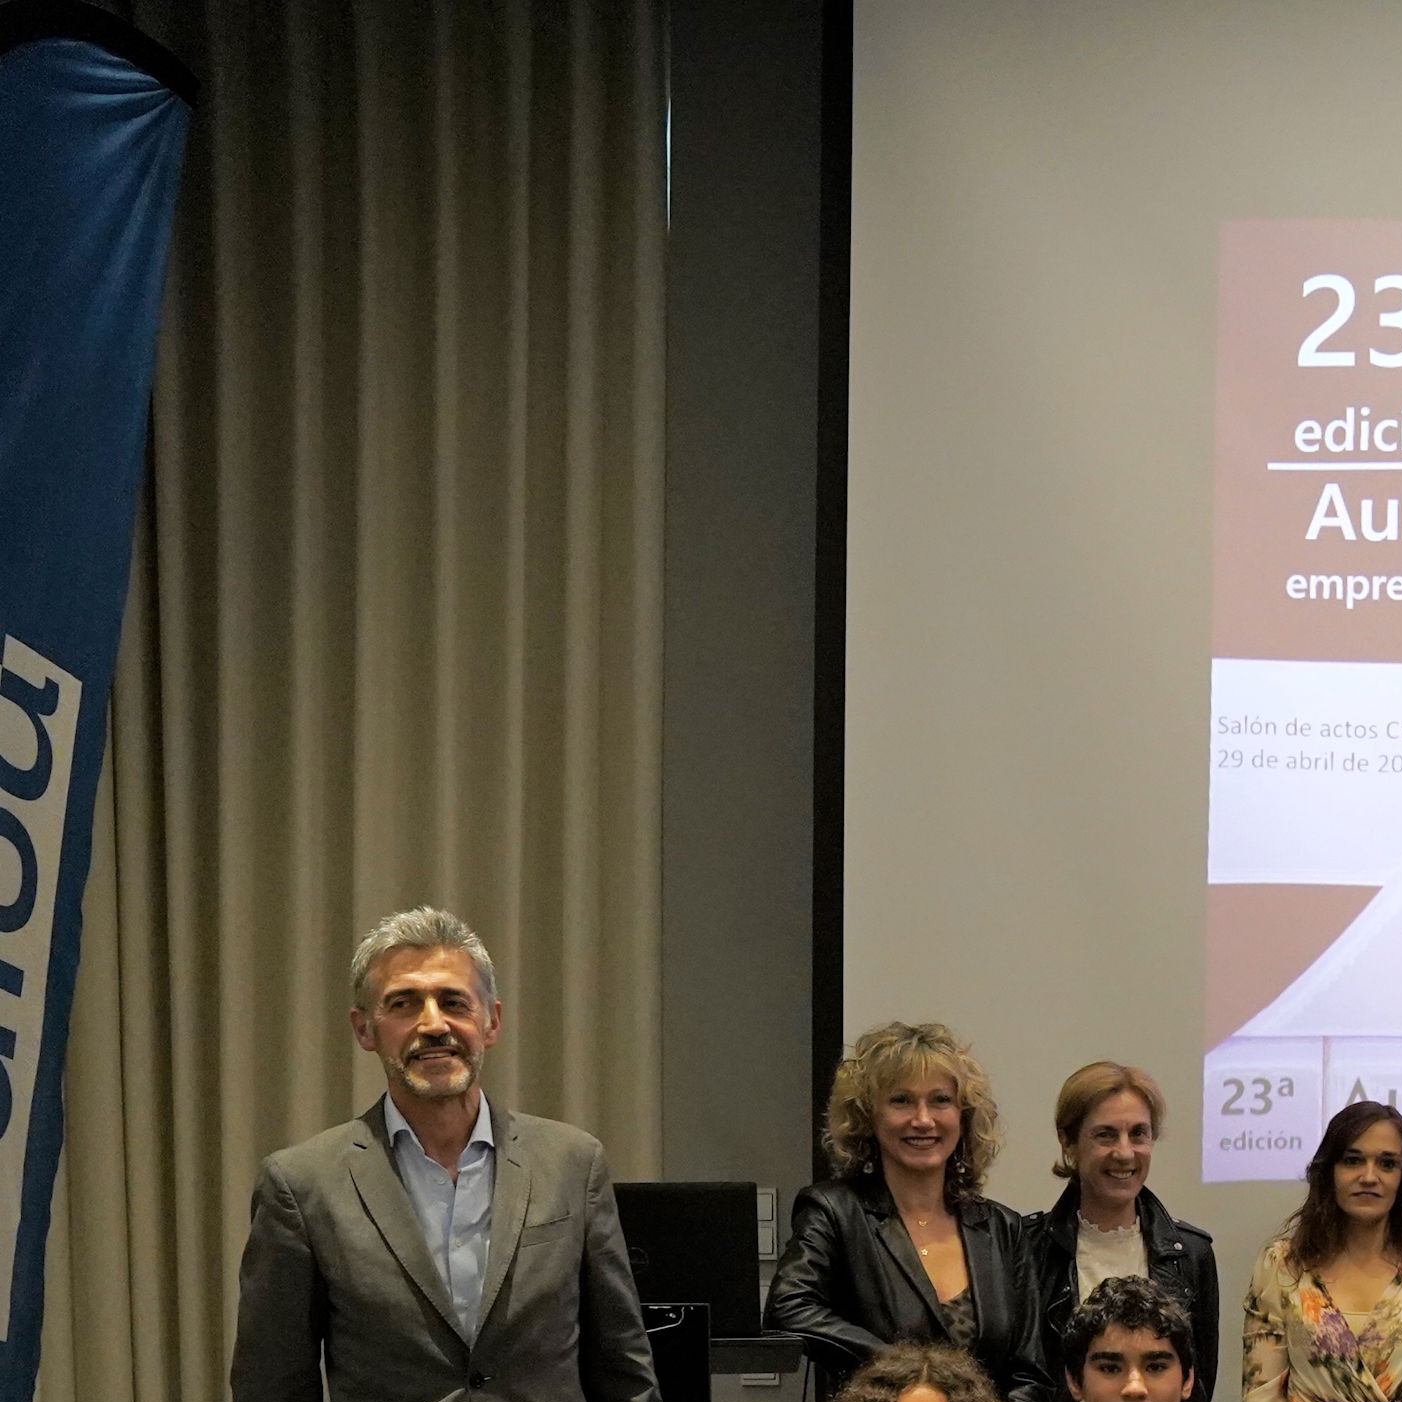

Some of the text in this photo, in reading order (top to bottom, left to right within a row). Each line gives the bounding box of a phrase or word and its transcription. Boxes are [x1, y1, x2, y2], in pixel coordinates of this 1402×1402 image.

[1217, 715, 1277, 736] Salón
[1285, 717, 1312, 737] de
[1320, 721, 1379, 740] actos
[1217, 749, 1244, 769] 29
[1251, 749, 1279, 769] de
[1286, 750, 1335, 771] abril
[1342, 752, 1369, 772] de
[1220, 1075, 1294, 1116] 23ª
[1219, 1131, 1302, 1152] edición
